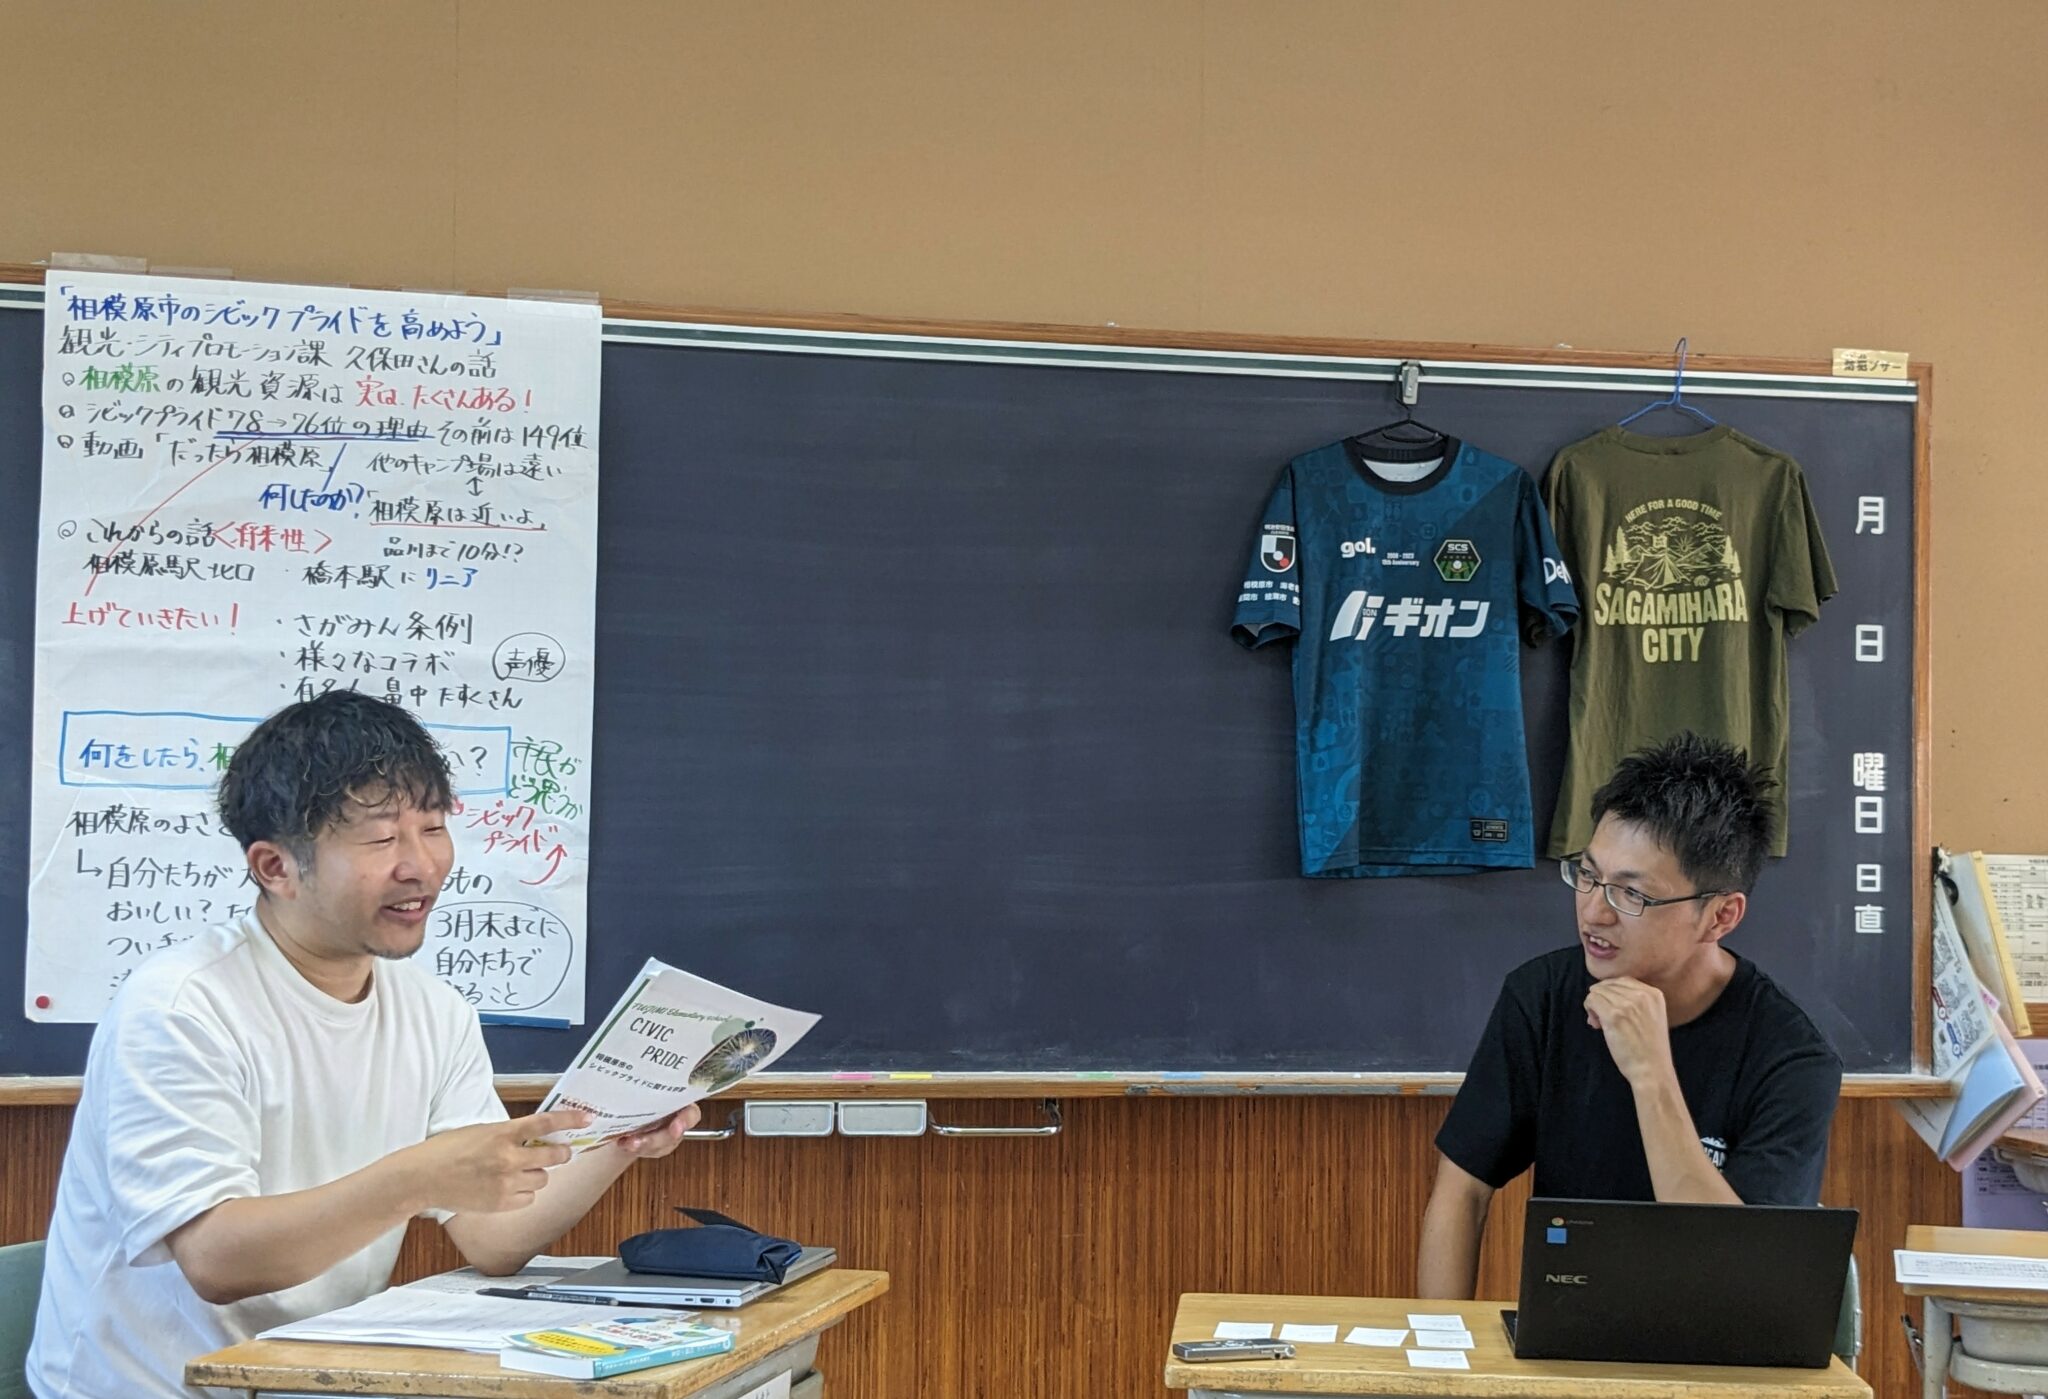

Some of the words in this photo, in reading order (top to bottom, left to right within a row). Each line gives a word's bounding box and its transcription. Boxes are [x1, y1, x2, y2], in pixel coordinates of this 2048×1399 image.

[1624, 507, 1648, 523] HERE
[1648, 500, 1665, 511] FOR
[1667, 498, 1674, 508] A
[1675, 499, 1699, 511] GOOD
[1700, 504, 1723, 520] TIME
[1855, 496, 1885, 535] 月
[1447, 543, 1468, 552] SCS
[1383, 597, 1490, 638] ギオン
[1594, 578, 1749, 626] SAGAMIHARA
[1642, 627, 1705, 663] CITY
[1855, 624, 1884, 663] 日
[436, 946, 542, 978] 自分たちで
[629, 1017, 674, 1043] CIVIC
[640, 1045, 689, 1071] PRIDE
[1545, 1273, 1589, 1285] NEC
